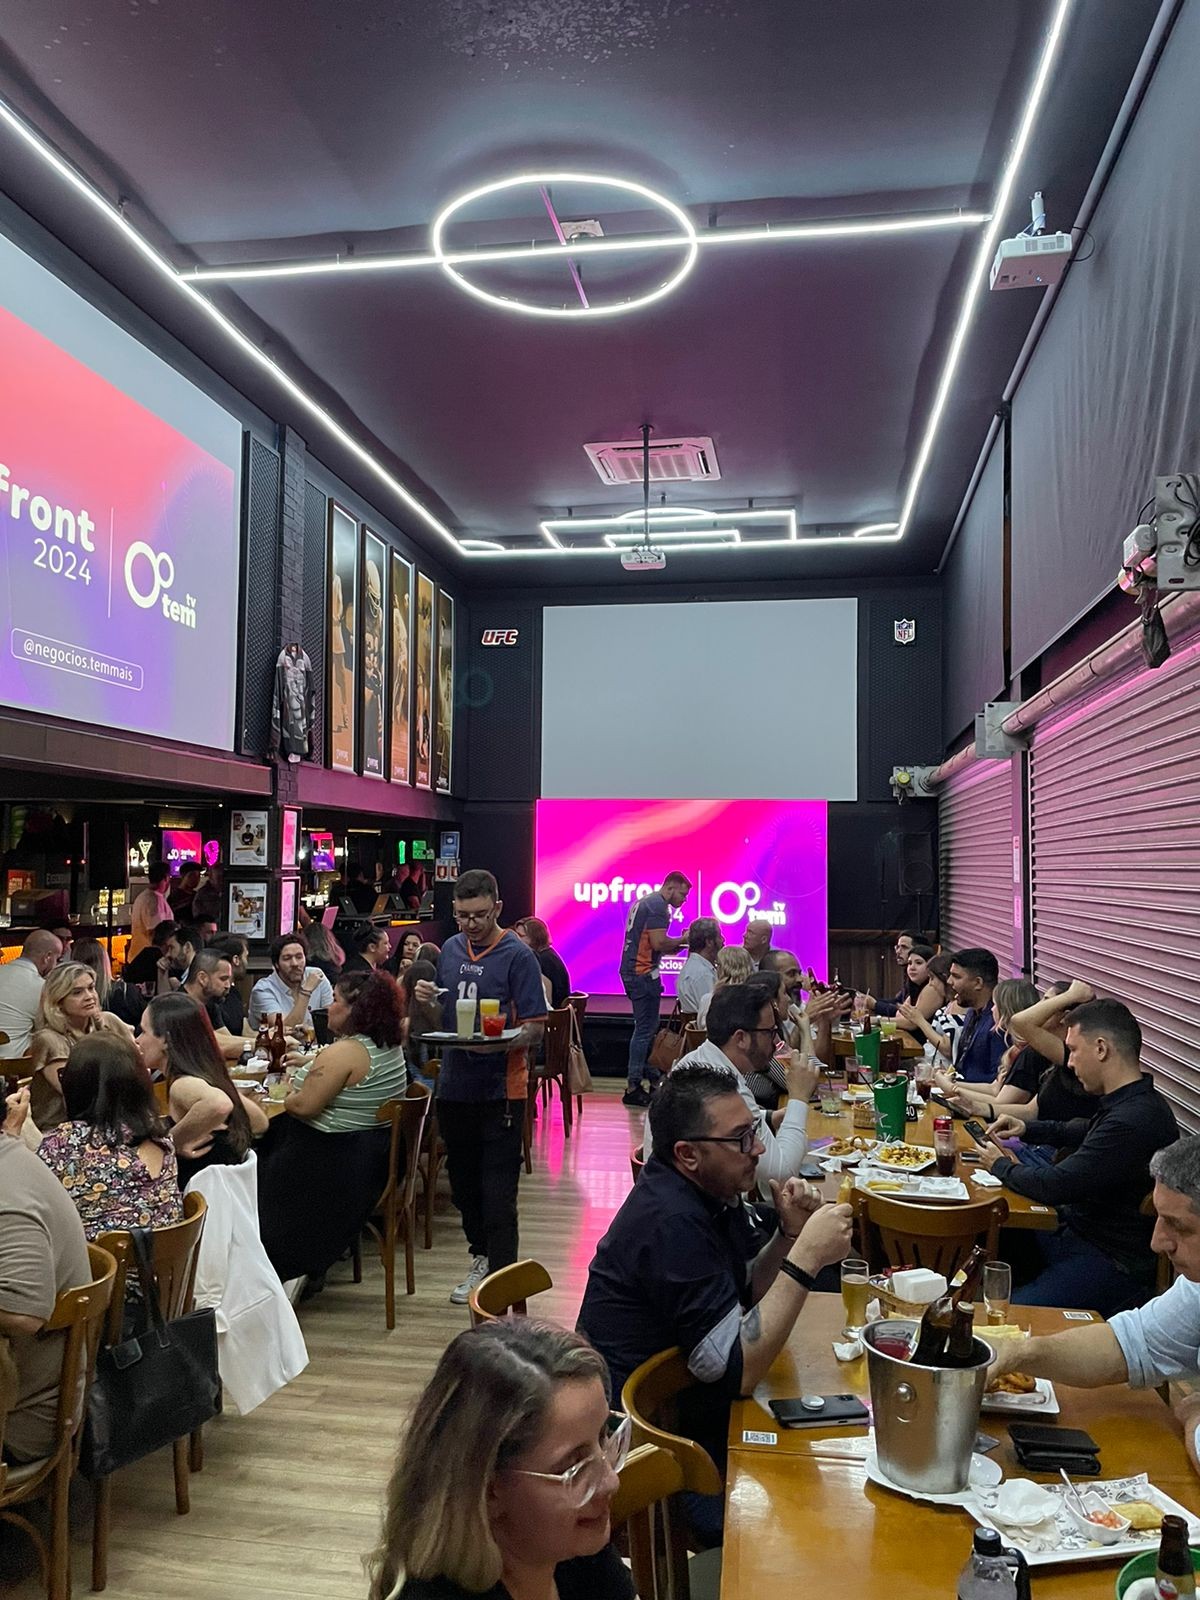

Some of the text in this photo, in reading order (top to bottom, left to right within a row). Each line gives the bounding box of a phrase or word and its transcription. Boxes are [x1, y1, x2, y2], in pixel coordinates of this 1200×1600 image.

[33, 537, 92, 586] 2024
[161, 593, 196, 629] tem
[185, 593, 197, 608] tv
[481, 629, 519, 645] UFC
[896, 629, 913, 640] NFL
[23, 637, 134, 682] @negocios.temmais
